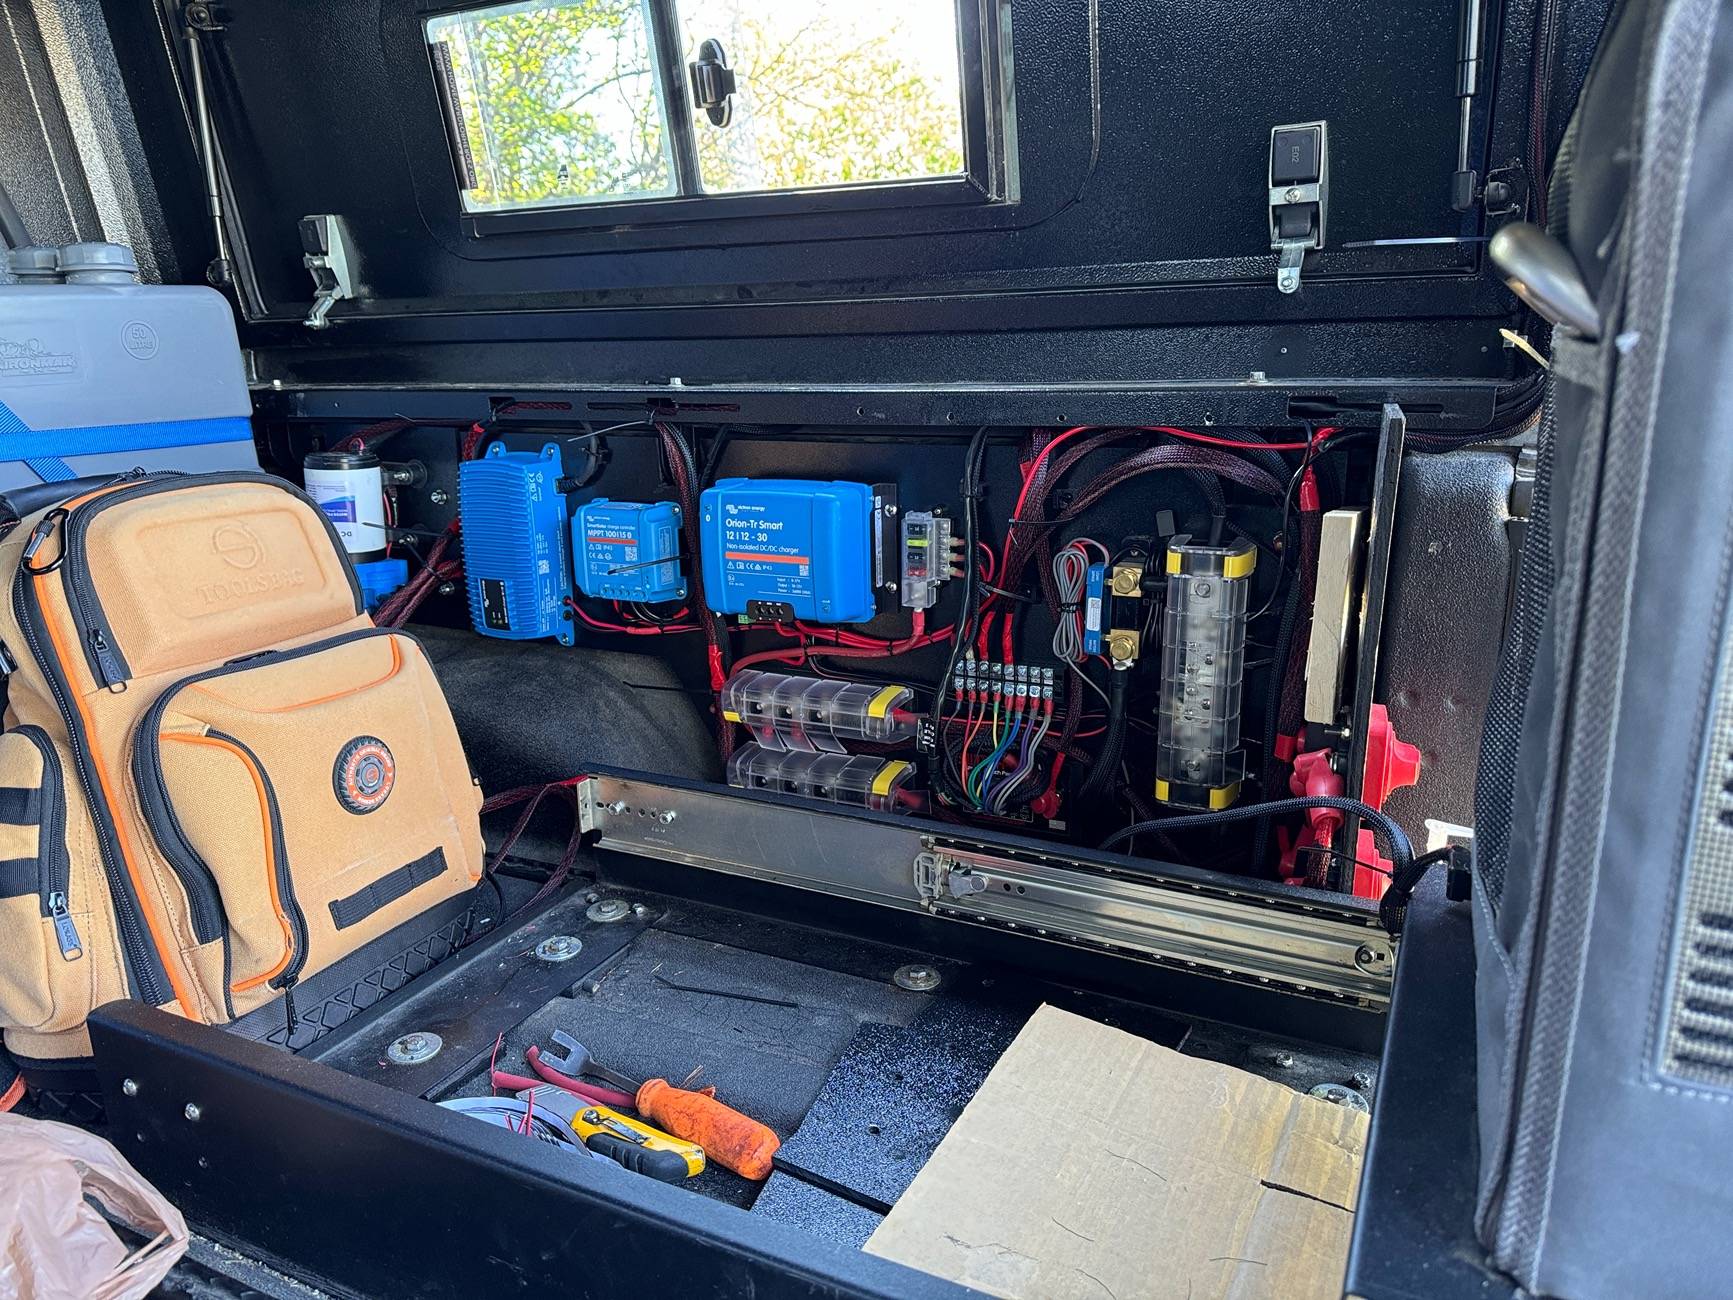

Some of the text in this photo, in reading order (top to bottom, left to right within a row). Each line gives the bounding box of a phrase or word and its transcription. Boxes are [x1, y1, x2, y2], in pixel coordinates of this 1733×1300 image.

[131, 328, 146, 339] 50
[725, 518, 784, 530] Orion-Tr Smart
[588, 529, 604, 537] MPPT
[726, 543, 759, 551] Non-isolated
[779, 546, 800, 555] charger
